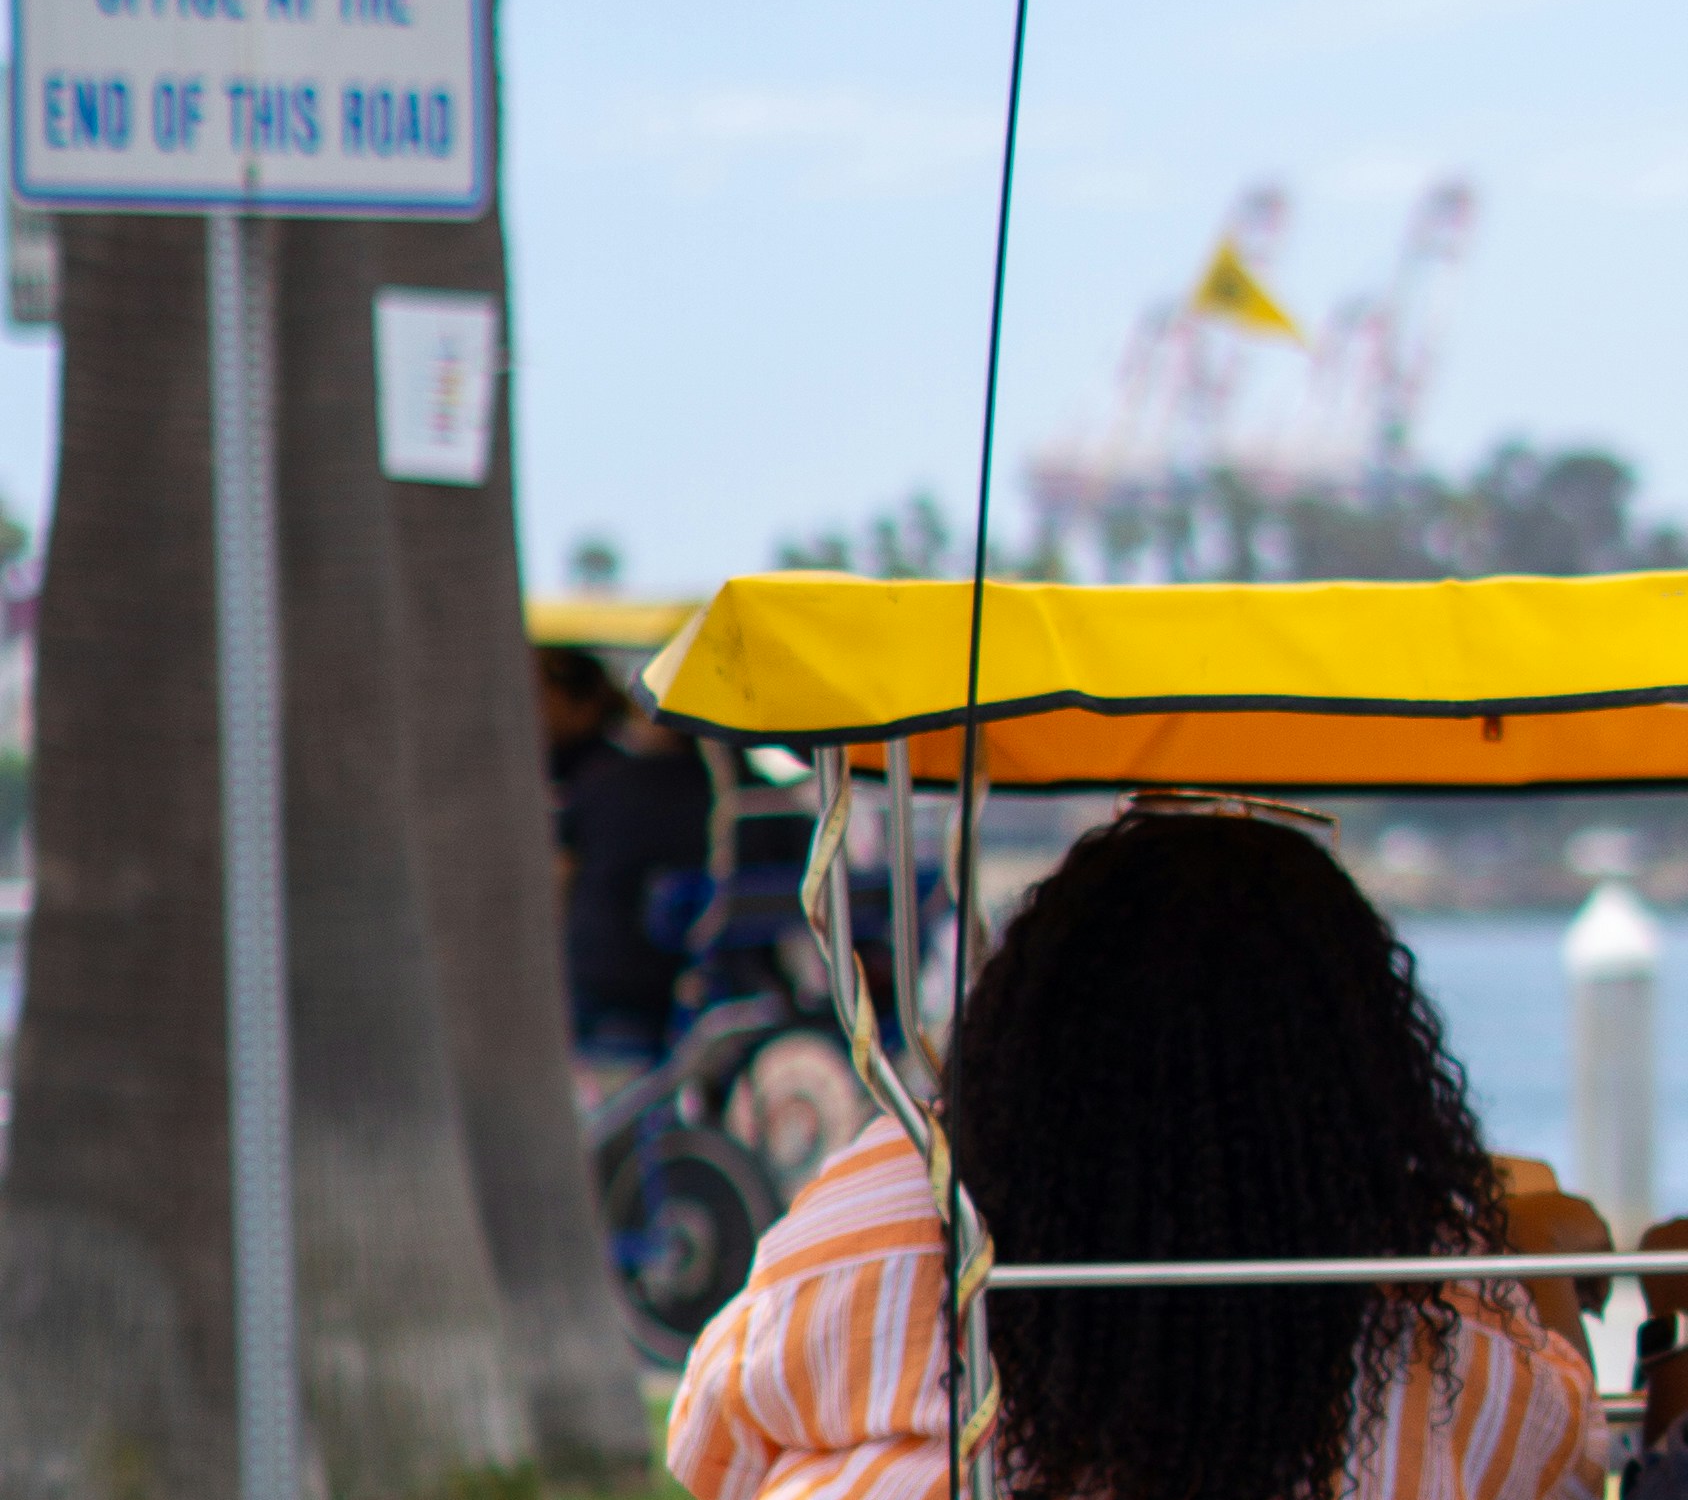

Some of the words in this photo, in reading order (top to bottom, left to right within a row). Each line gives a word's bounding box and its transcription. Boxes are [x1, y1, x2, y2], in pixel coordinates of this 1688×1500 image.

[43, 74, 130, 149] END
[154, 78, 203, 152] OF
[225, 81, 320, 156] THIS
[343, 88, 454, 160] ROAD
